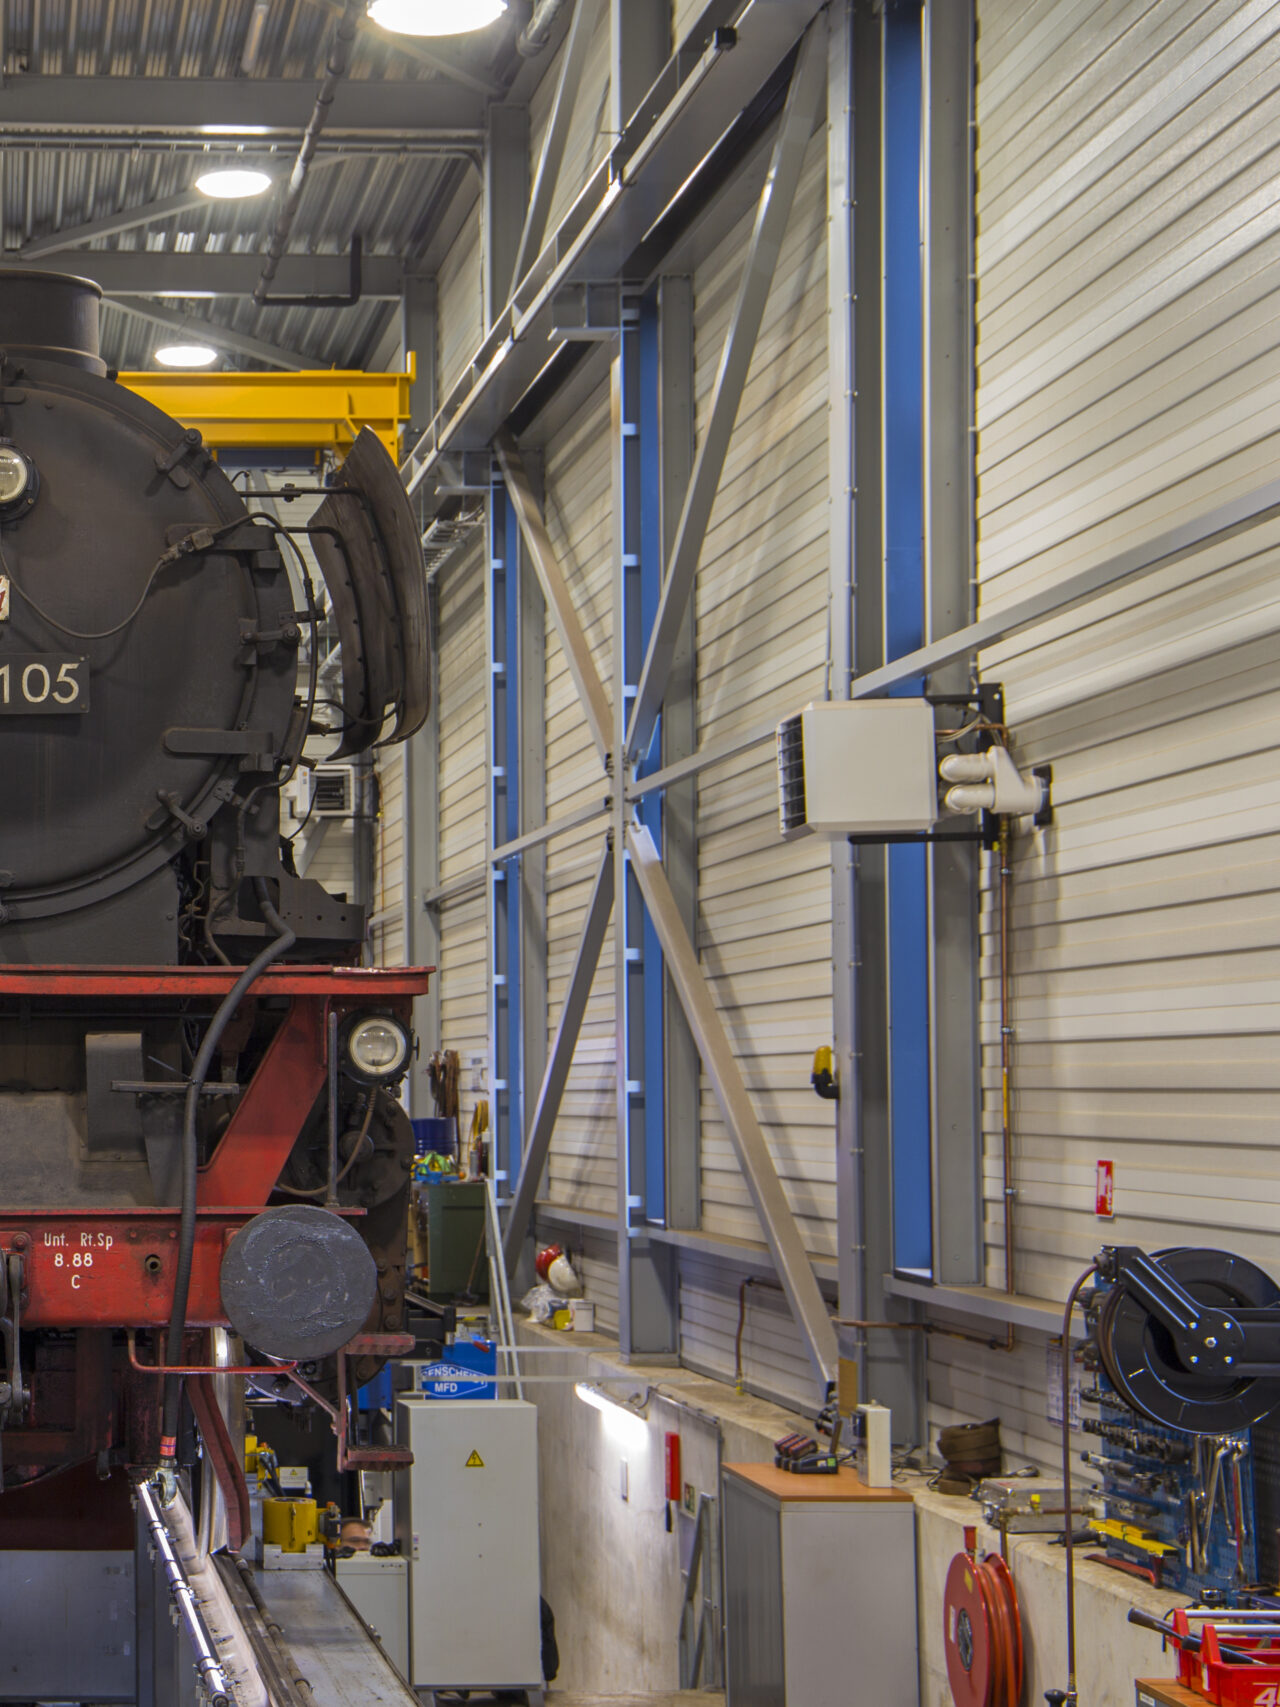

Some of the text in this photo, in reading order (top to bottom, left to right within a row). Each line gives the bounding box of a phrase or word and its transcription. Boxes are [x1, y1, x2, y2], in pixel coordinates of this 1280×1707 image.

[43, 1232, 69, 1247] Unt.
[54, 1253, 94, 1267] 8.88
[71, 1274, 81, 1289] C
[434, 1382, 458, 1393] MFD
